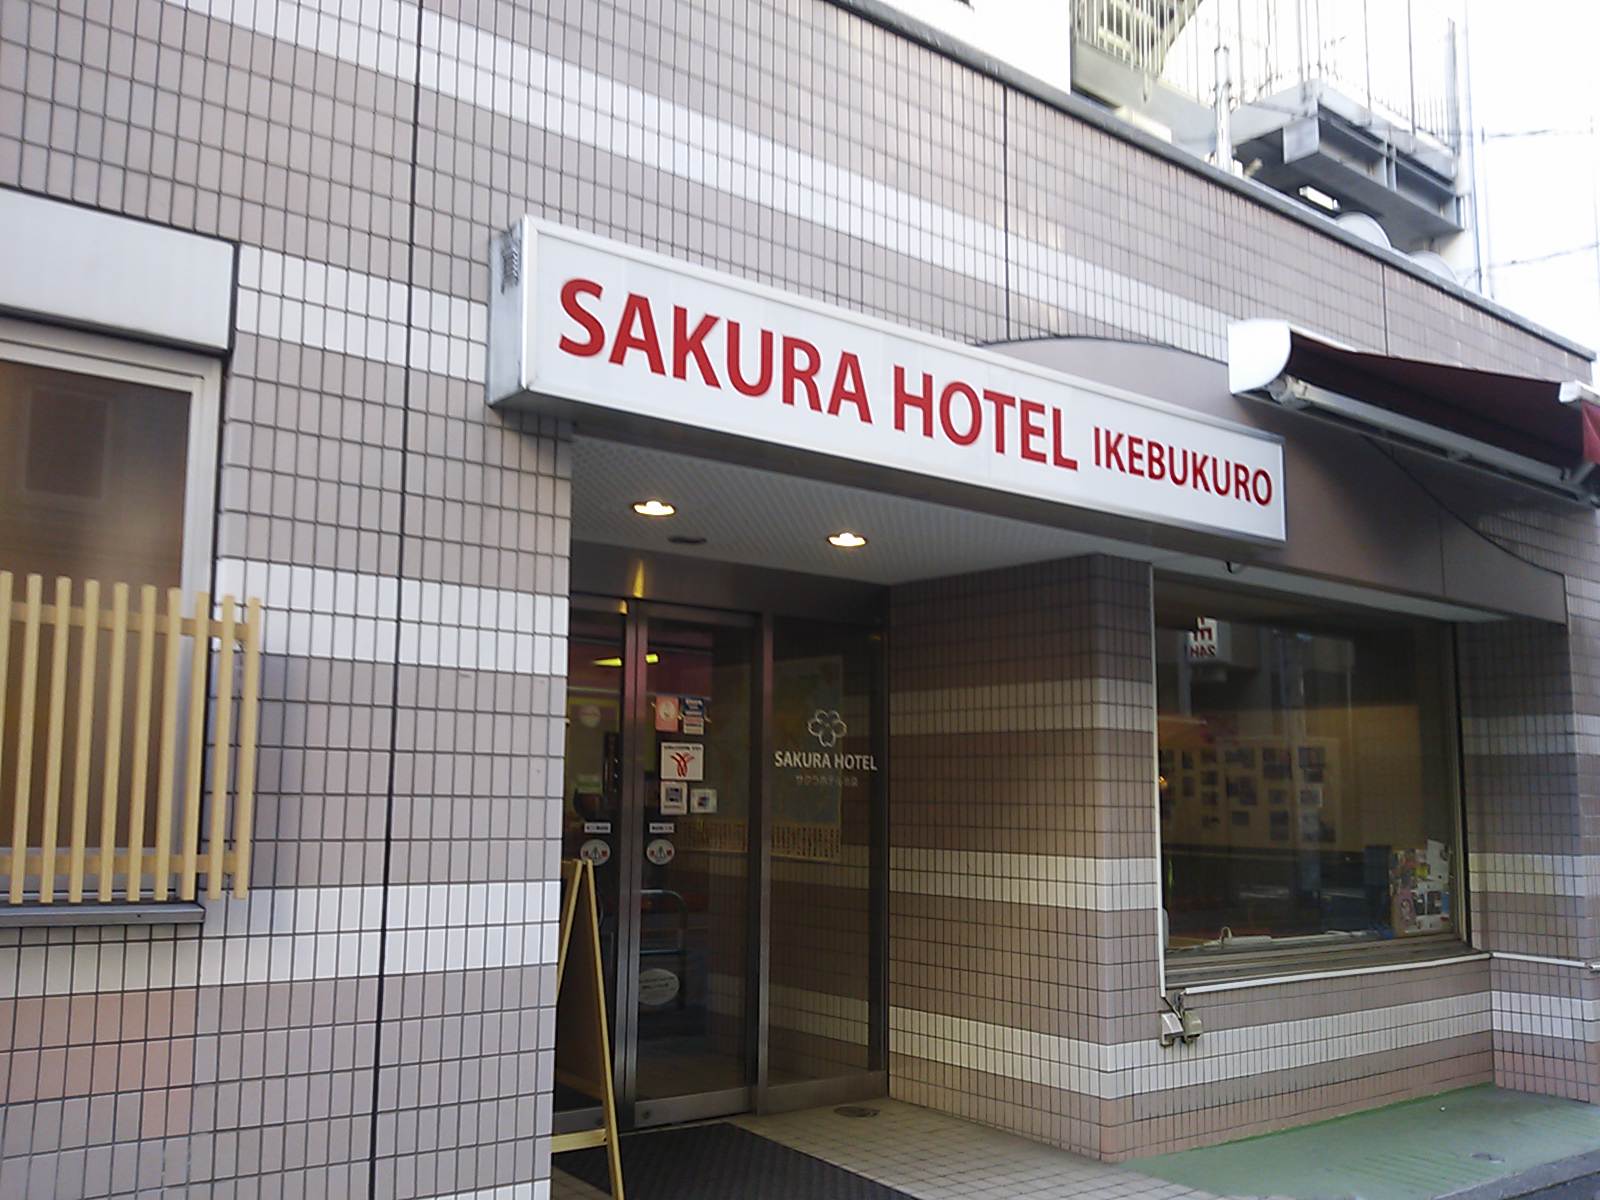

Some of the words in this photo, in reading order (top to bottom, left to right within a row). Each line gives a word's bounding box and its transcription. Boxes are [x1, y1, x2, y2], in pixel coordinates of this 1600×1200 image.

[559, 279, 873, 424] SAKURA
[893, 366, 1078, 471] HOTEL
[1093, 426, 1272, 506] IKEBUKURO
[774, 750, 832, 769] SAKURA
[834, 753, 878, 771] HOTEL
